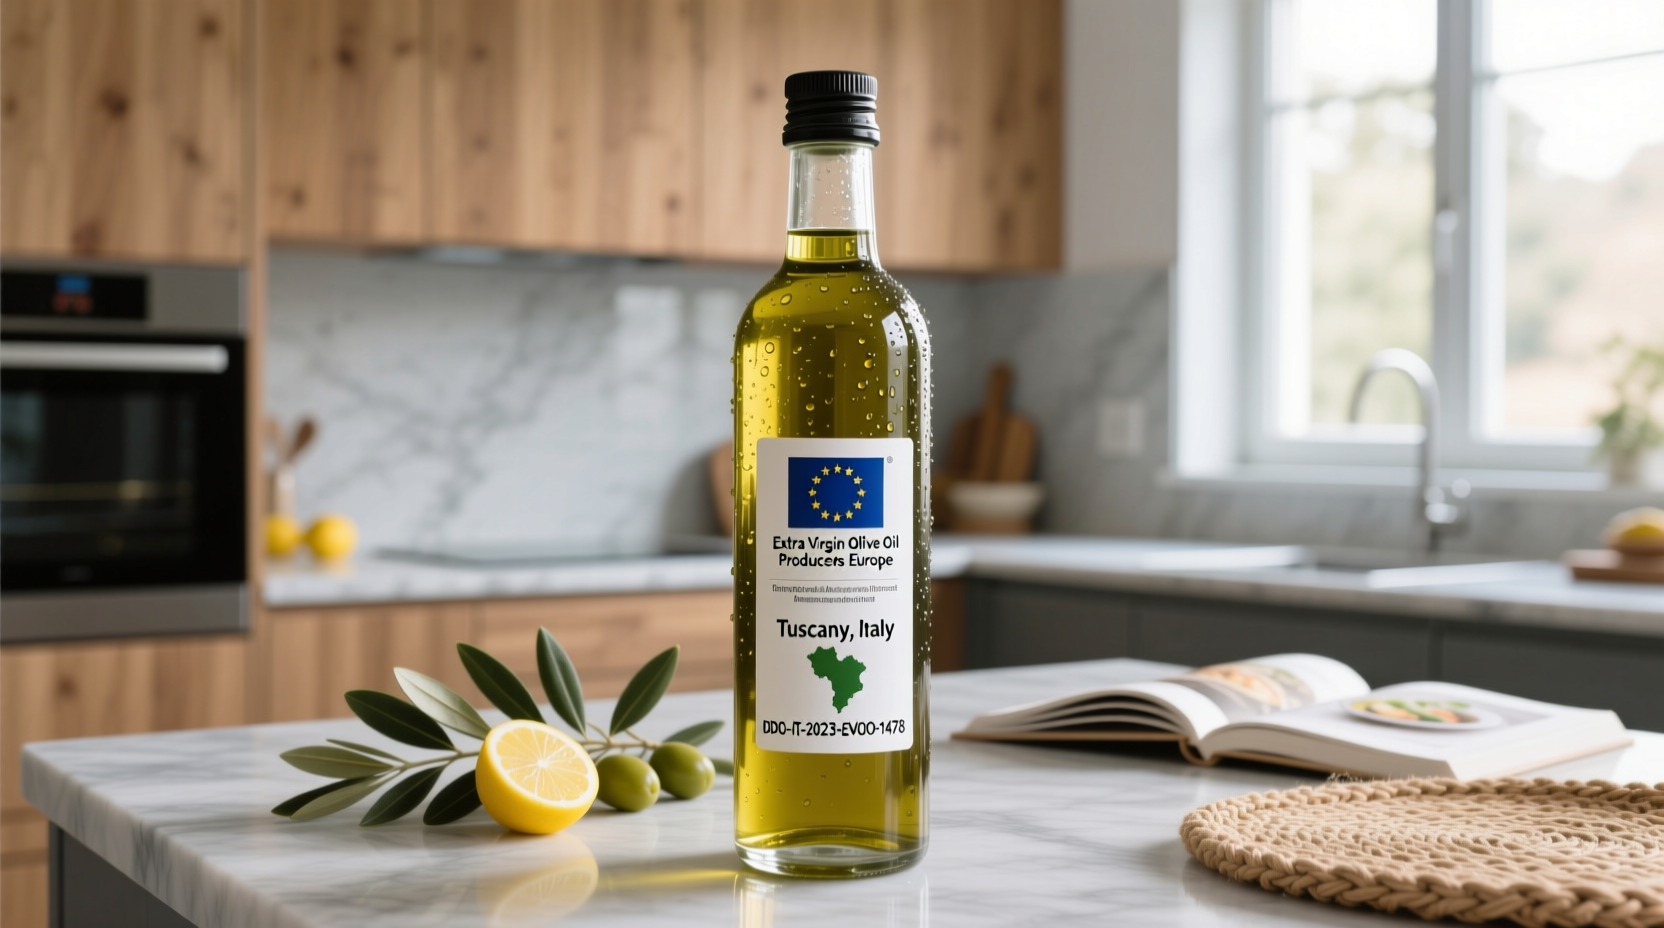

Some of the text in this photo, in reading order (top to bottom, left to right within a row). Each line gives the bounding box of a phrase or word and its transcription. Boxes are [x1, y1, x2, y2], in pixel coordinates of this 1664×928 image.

[808, 536, 845, 553] Virgin
[848, 536, 880, 549] Olive
[883, 535, 899, 549] Oil
[779, 552, 894, 571] Producers Europe
[776, 619, 895, 643] Tuscany, Italy
